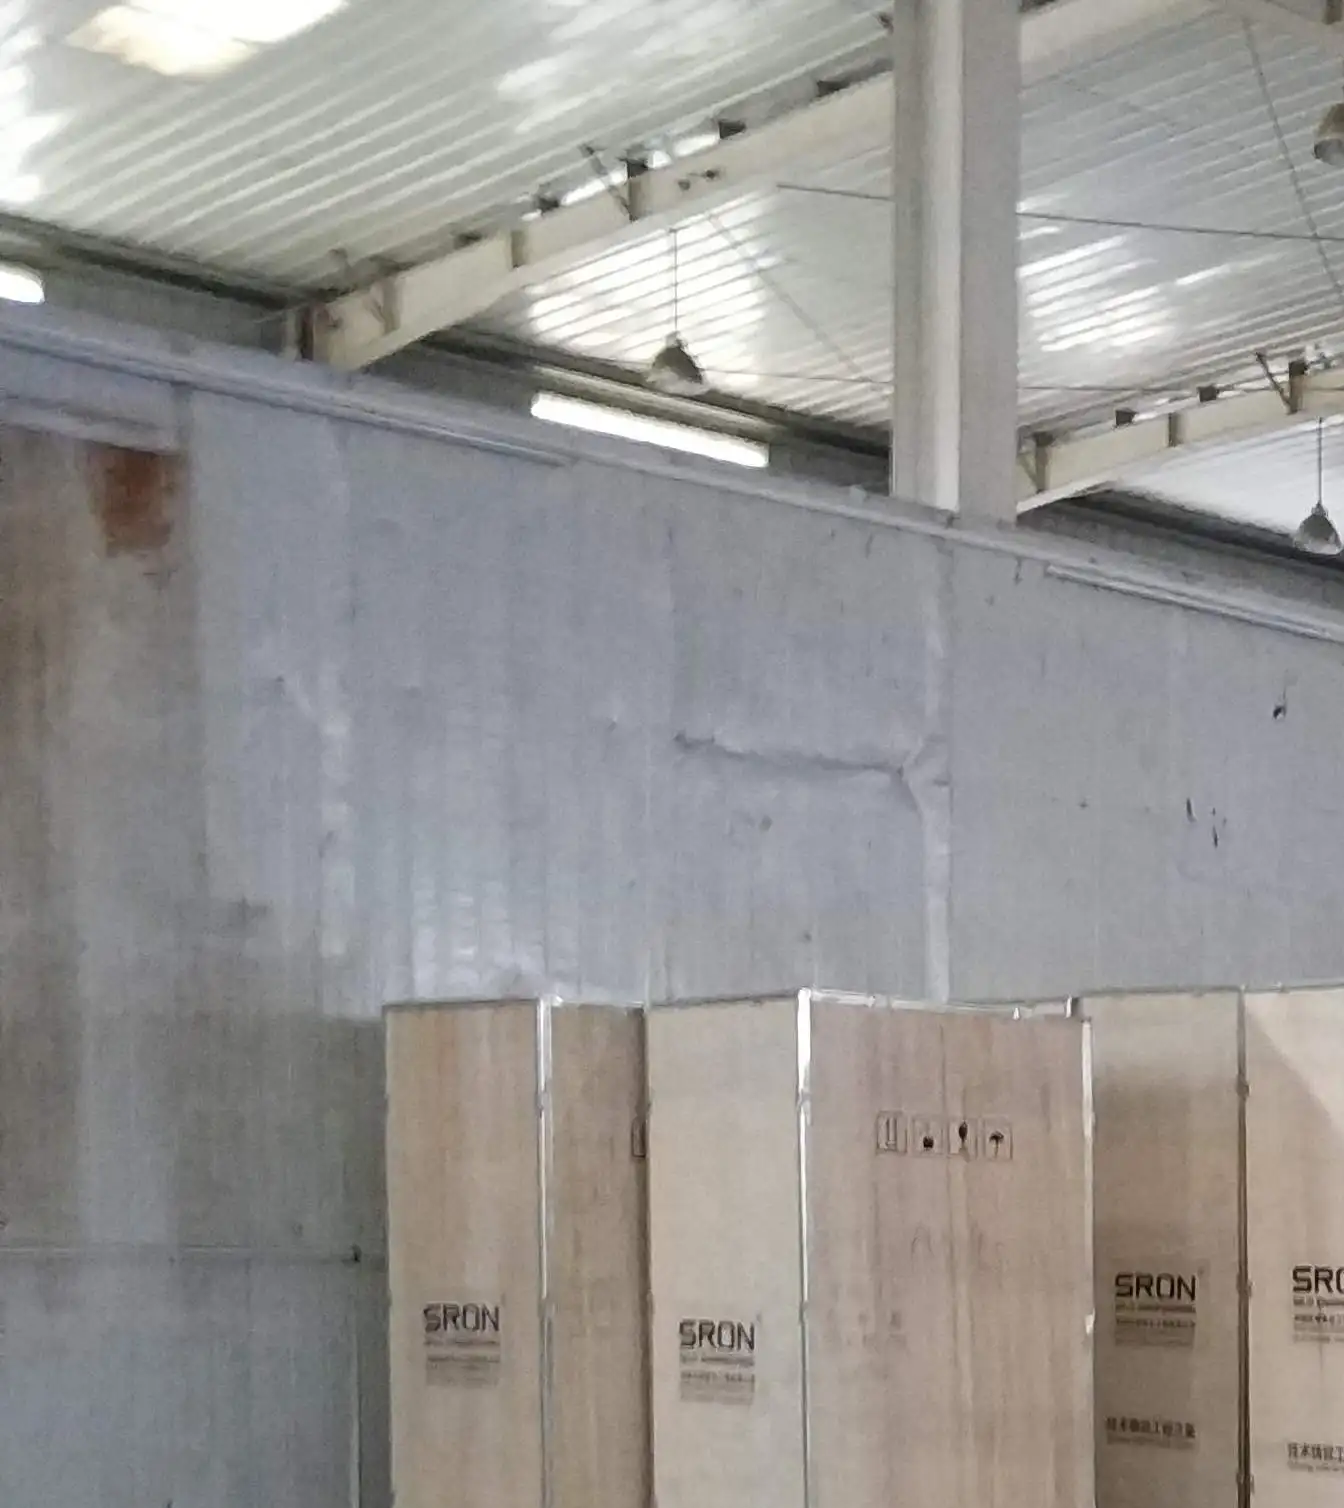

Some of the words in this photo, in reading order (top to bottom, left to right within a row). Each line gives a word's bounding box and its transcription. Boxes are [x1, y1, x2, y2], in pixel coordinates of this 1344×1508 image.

[1115, 1272, 1196, 1302] SRON
[423, 1303, 500, 1332] SRON
[679, 1319, 755, 1351] SRON
